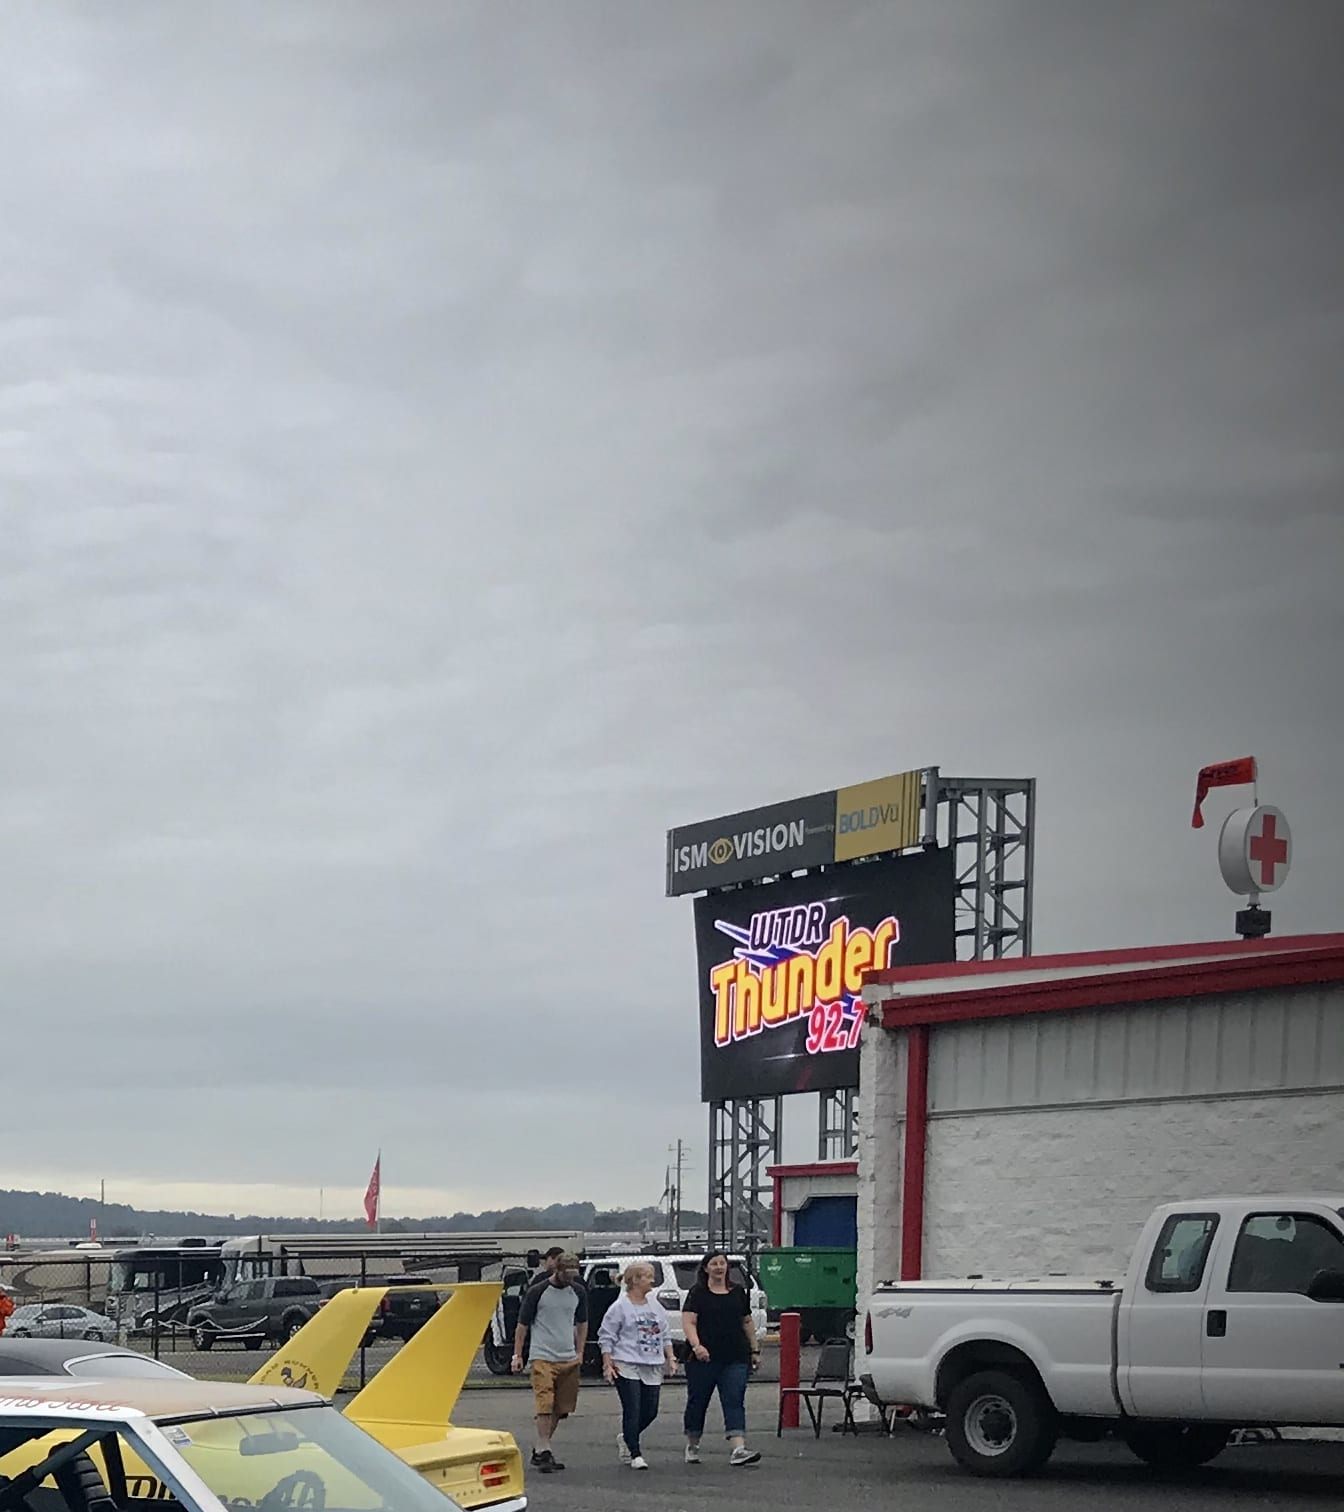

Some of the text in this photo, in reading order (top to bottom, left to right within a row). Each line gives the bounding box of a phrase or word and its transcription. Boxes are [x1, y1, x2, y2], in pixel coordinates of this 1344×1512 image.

[674, 819, 805, 873] ISM VISION
[750, 903, 826, 950] WTDR
[710, 916, 900, 1047] Thunder
[807, 1001, 866, 1053] 92.7
